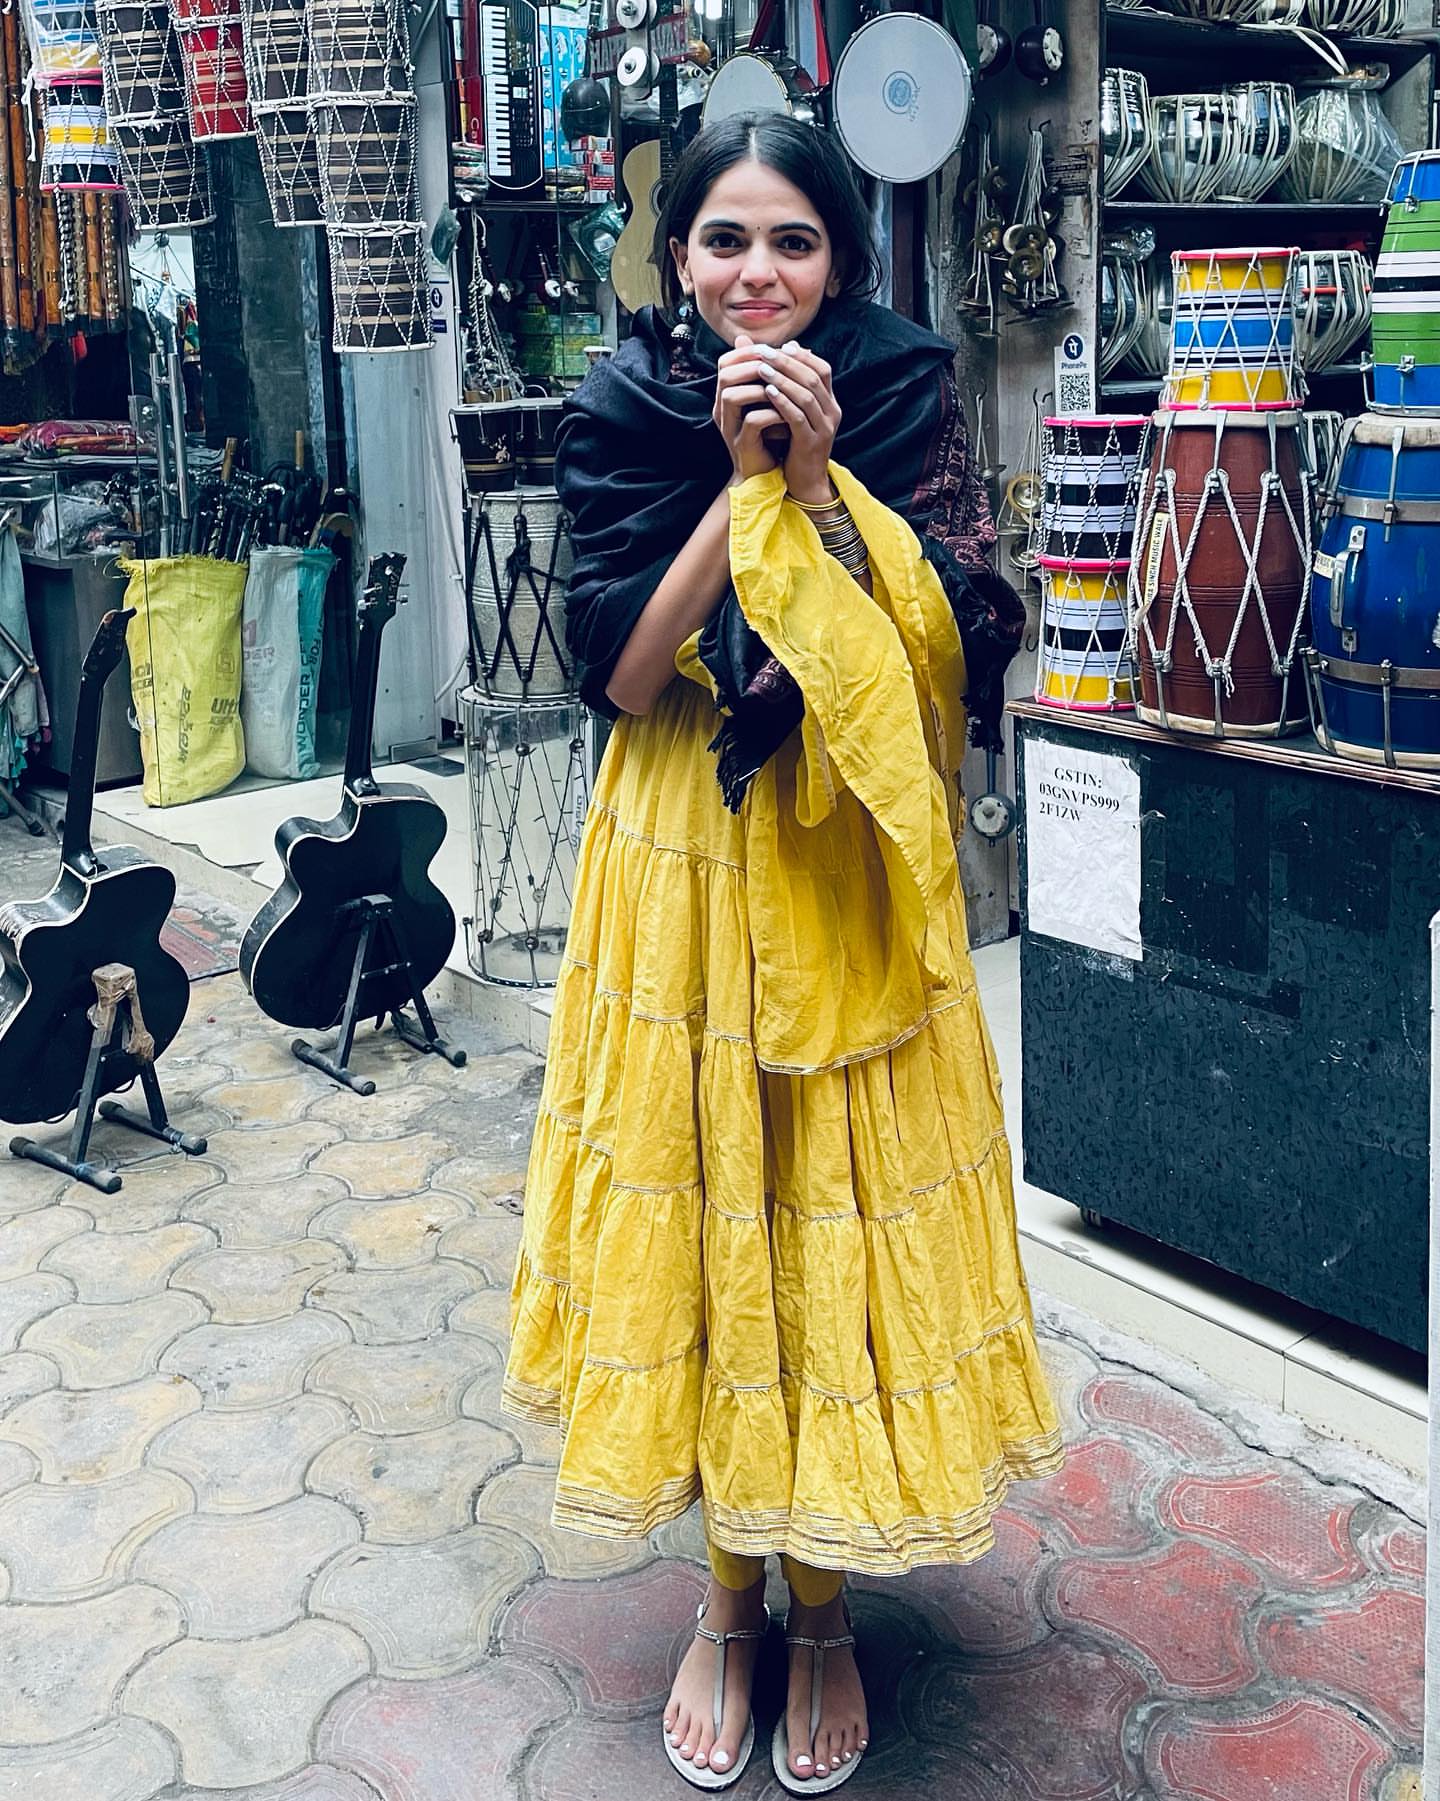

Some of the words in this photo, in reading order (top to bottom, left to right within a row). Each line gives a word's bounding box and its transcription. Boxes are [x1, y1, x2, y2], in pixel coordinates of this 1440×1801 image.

[1151, 540, 1160, 565] MUSIC
[1054, 767, 1102, 789] GSTIN:
[1039, 782, 1120, 816] 03GNVPS999
